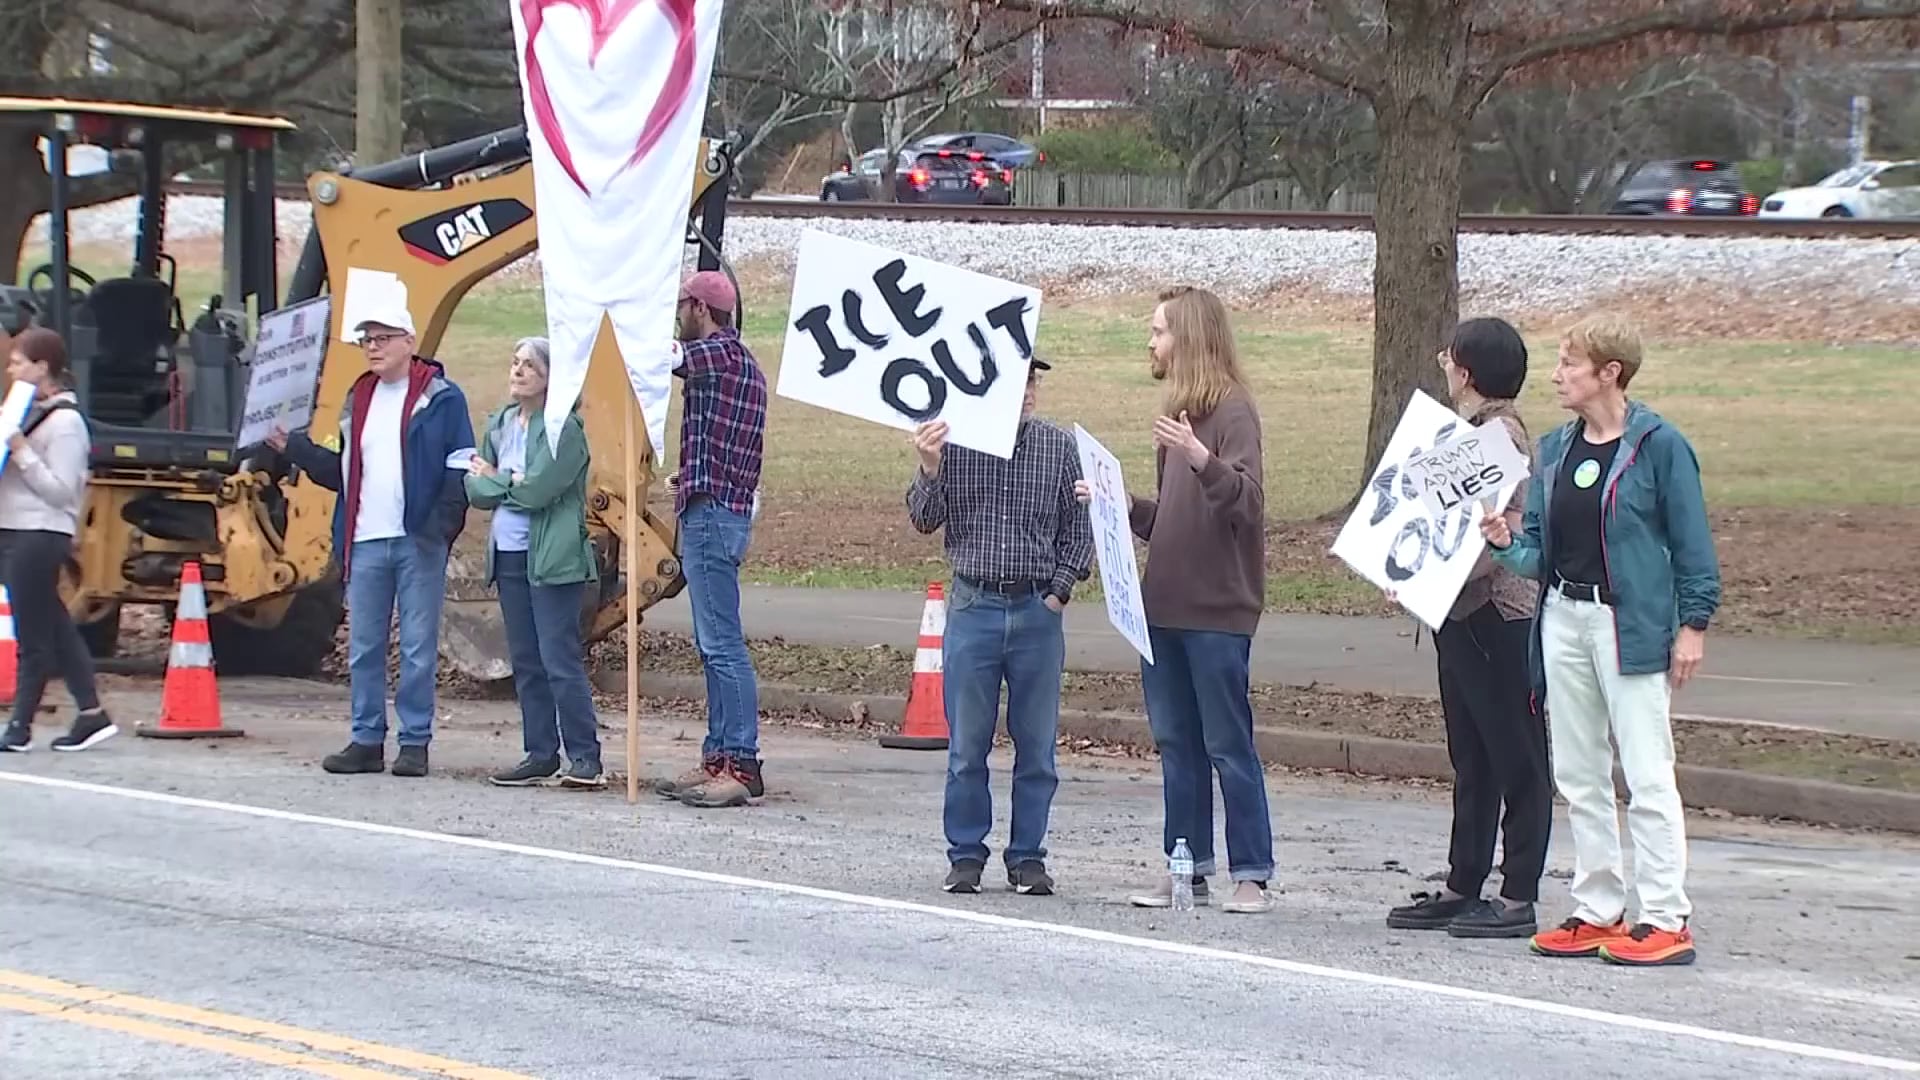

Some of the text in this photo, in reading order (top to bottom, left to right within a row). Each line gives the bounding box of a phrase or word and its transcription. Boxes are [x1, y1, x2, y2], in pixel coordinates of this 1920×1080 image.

[436, 204, 491, 256] CAT
[794, 258, 943, 378] ICE
[880, 296, 1033, 422] OUT
[1090, 451, 1115, 501] ICE
[1409, 438, 1480, 474] TRUMP
[1423, 449, 1485, 493] ADMIN
[1436, 464, 1504, 511] LIES
